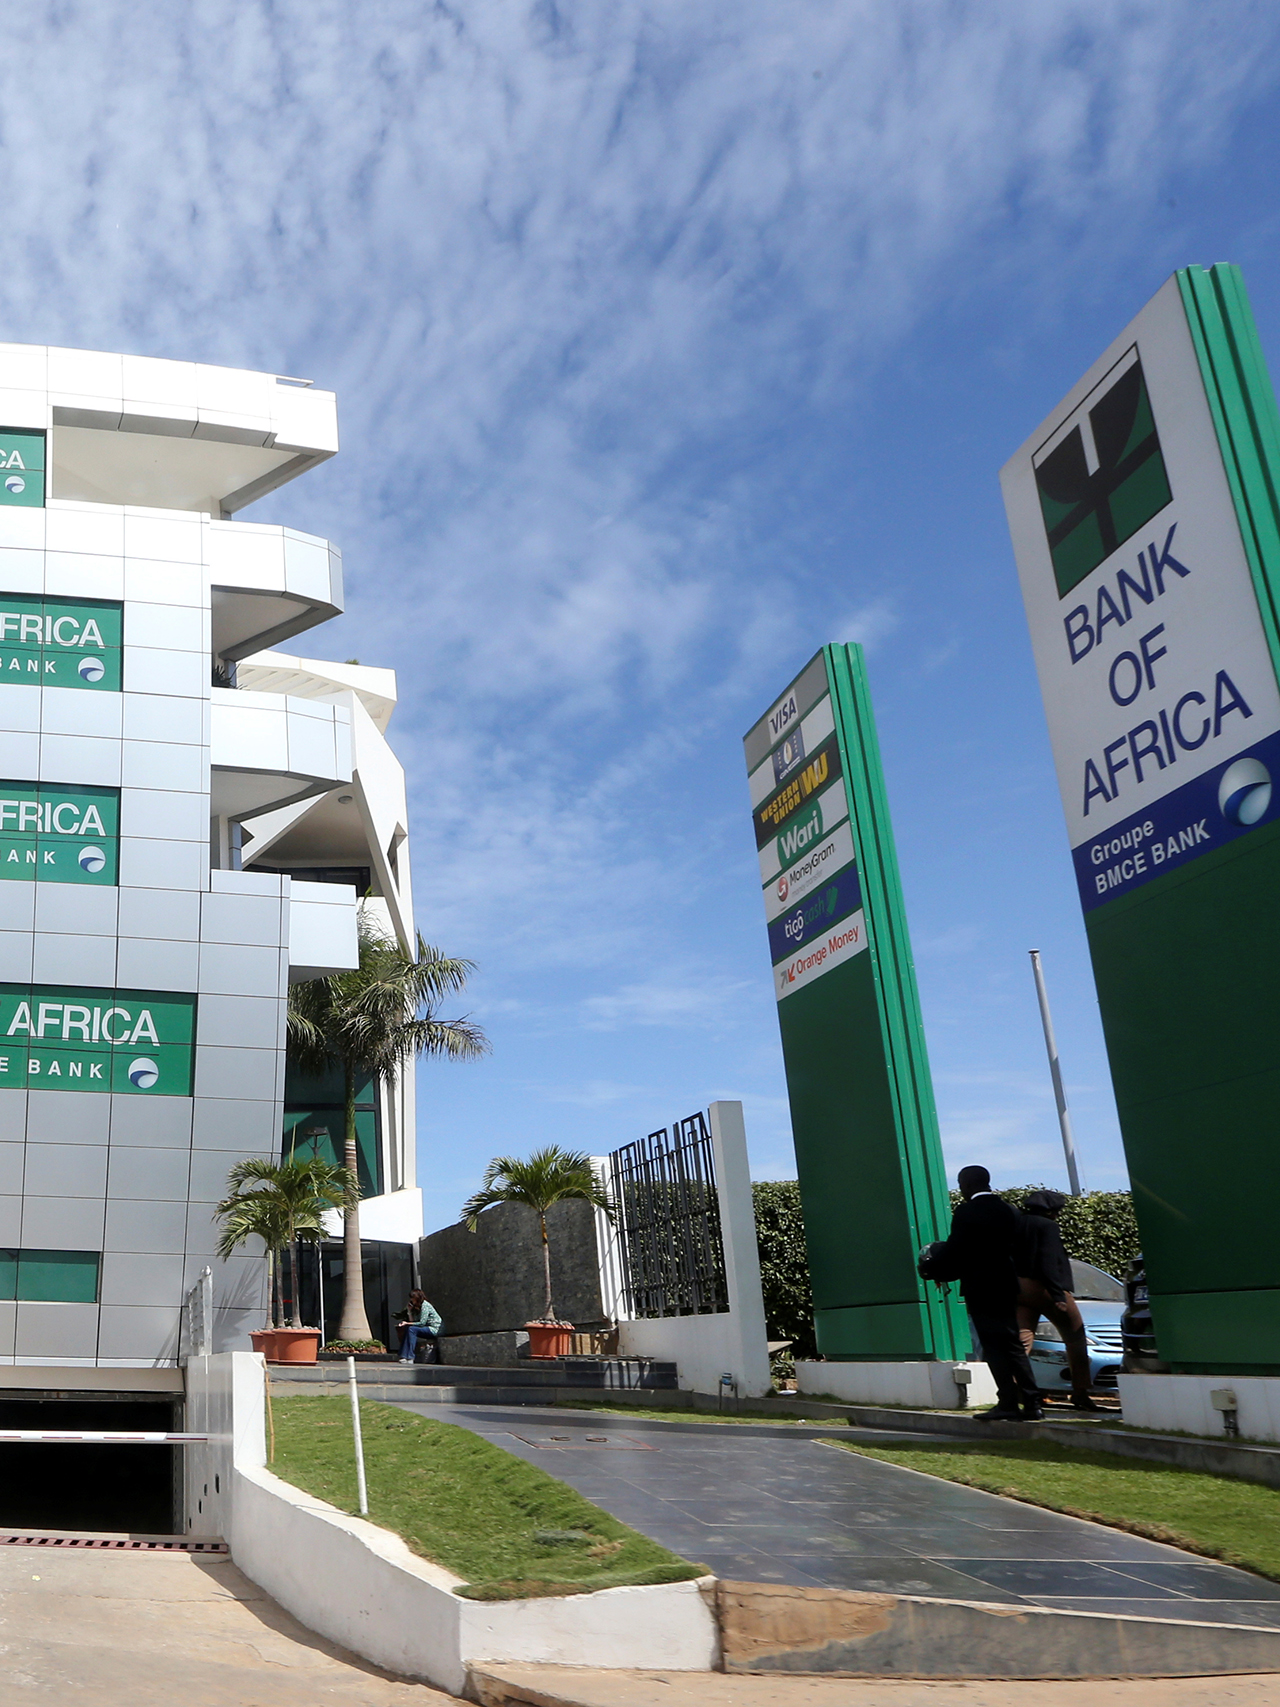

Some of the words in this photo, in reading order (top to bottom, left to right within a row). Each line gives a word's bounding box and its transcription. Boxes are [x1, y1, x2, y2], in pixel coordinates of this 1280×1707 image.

[1062, 521, 1192, 665] BANK
[1108, 622, 1168, 707] OF
[769, 696, 797, 734] VISA
[1083, 668, 1254, 817] AFRICA
[760, 779, 800, 823] WESTERN
[773, 791, 801, 825] UNION
[780, 810, 820, 859] Wari
[1090, 820, 1155, 865] Groupe
[1095, 851, 1148, 895] BMCE
[1151, 818, 1211, 865] BANK
[789, 843, 835, 886] MoneyGram
[796, 946, 827, 974] Orange
[828, 925, 859, 955] Money
[7, 1001, 161, 1048] AFRICA
[28, 1058, 104, 1080] BANK
